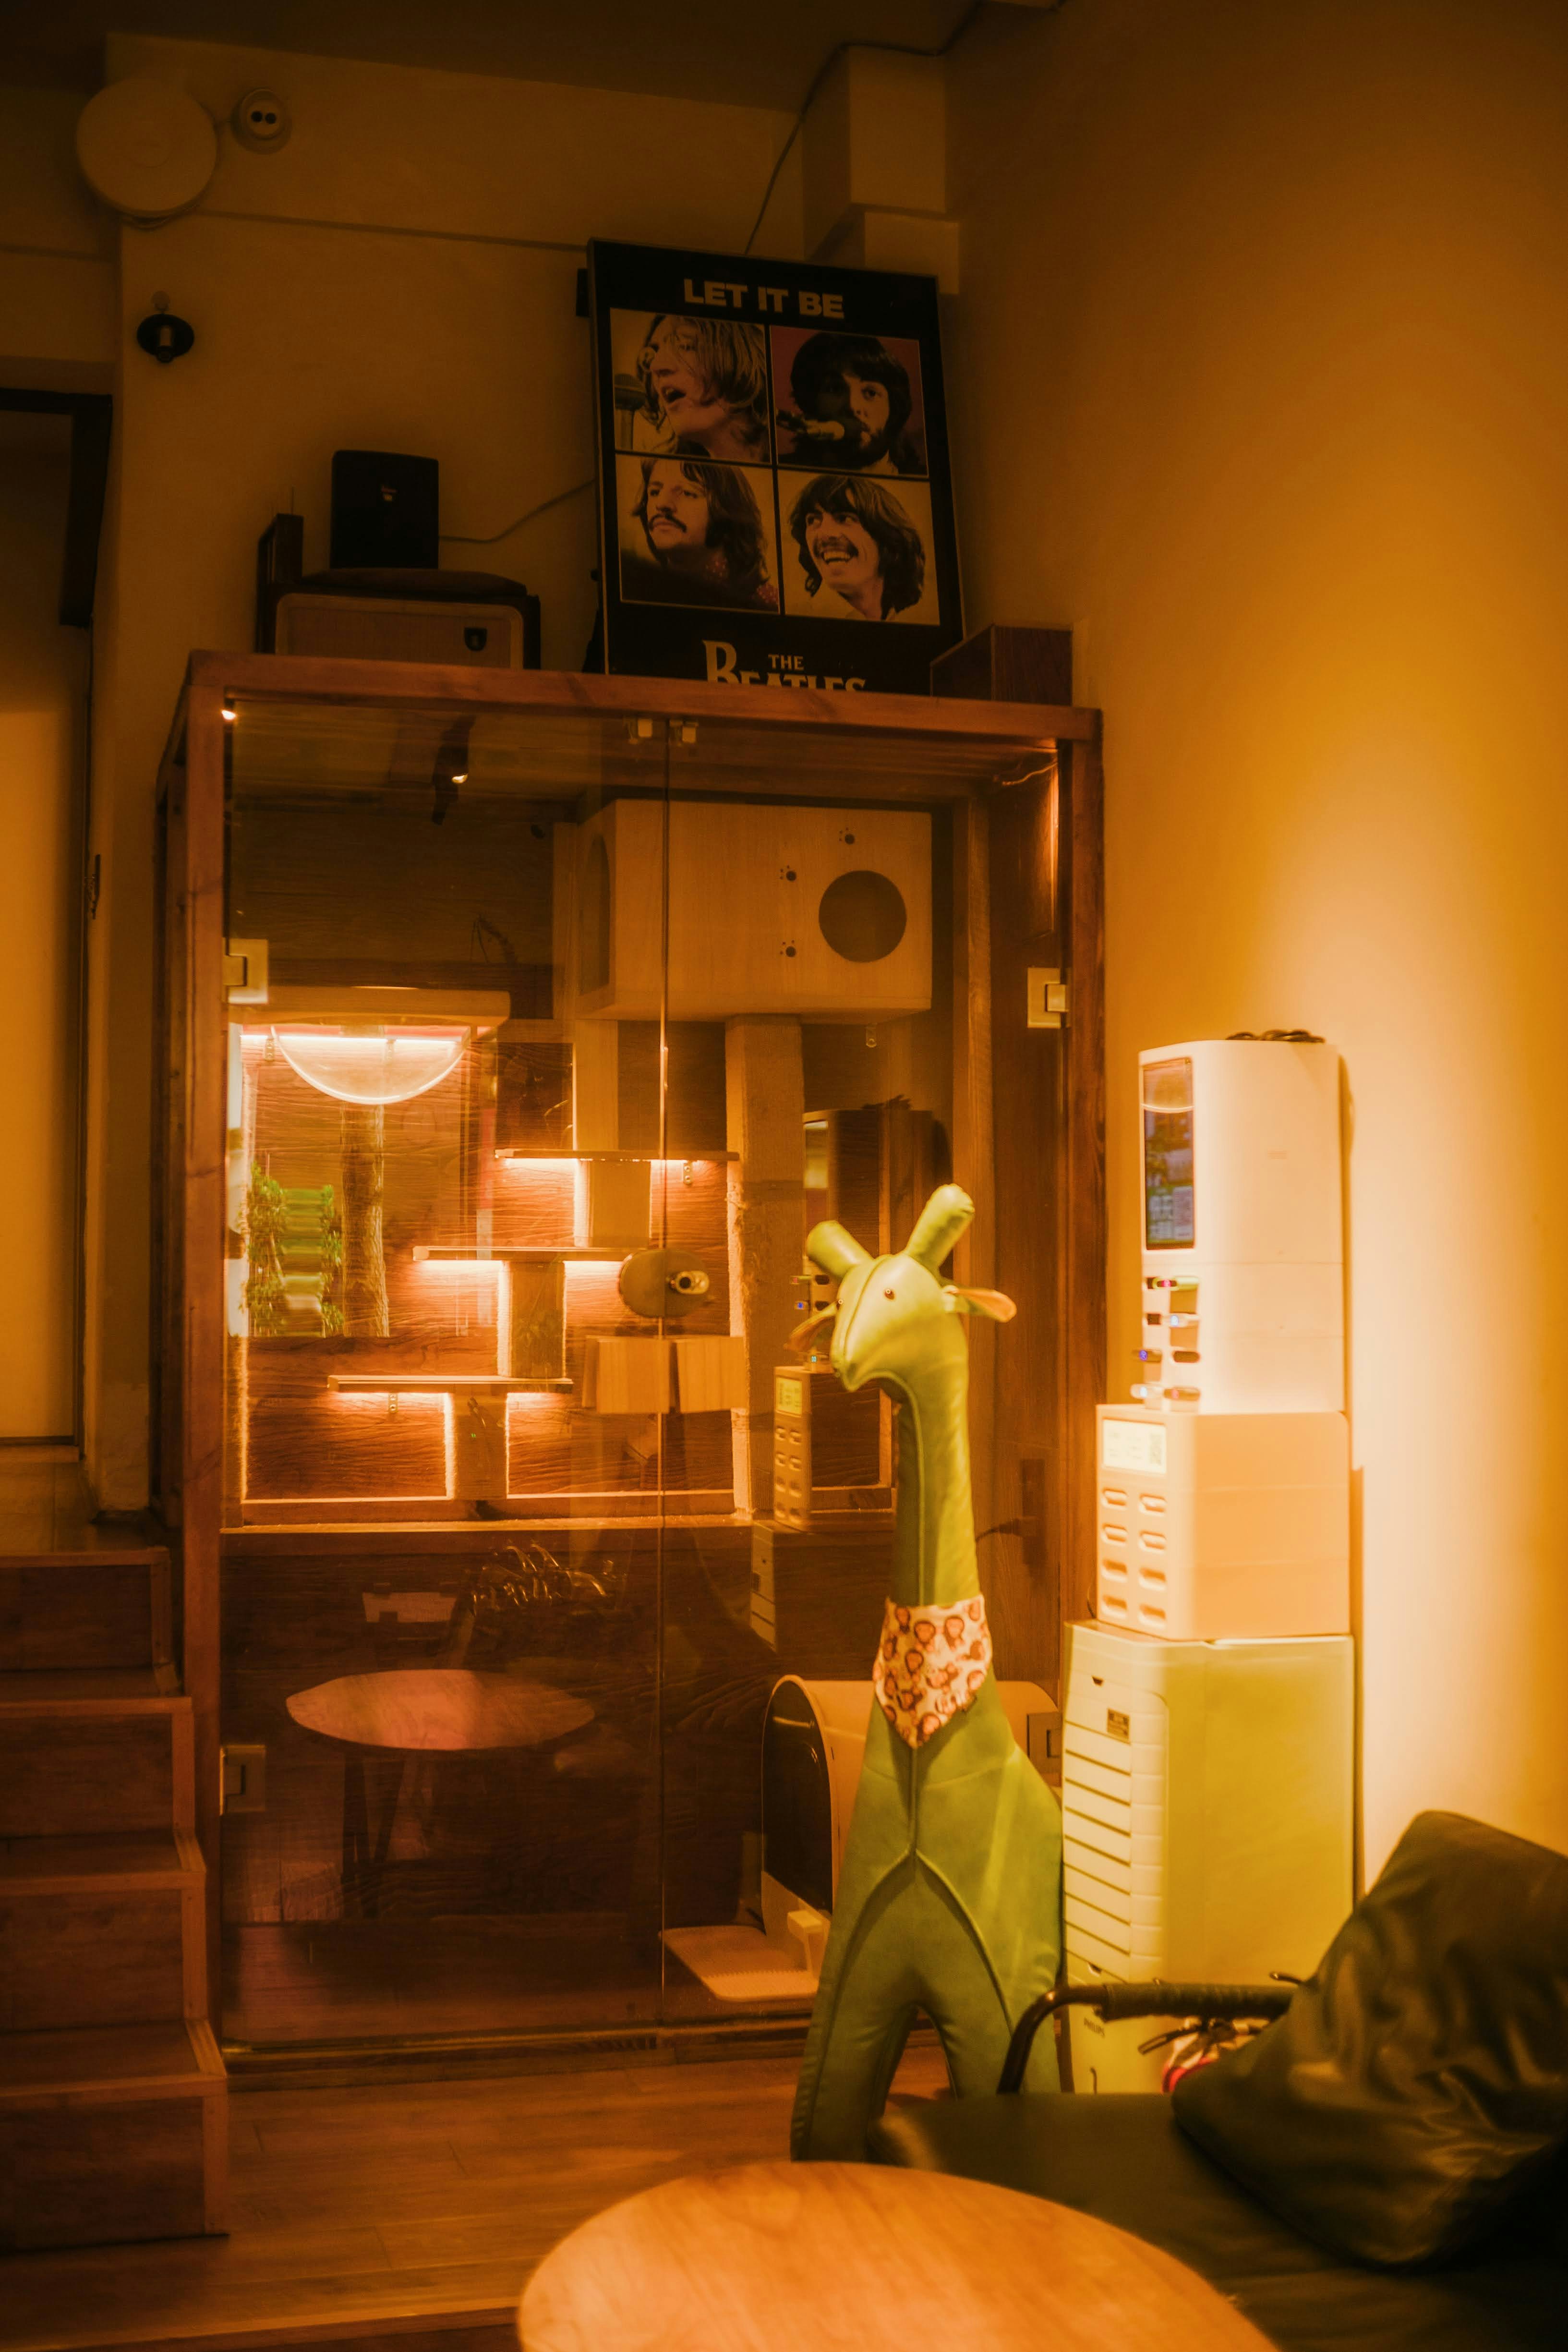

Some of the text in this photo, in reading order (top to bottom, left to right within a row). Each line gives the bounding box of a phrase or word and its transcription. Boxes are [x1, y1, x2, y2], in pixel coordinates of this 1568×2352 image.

[684, 278, 845, 319] LET IT BE
[768, 653, 805, 671] THE
[1084, 2017, 1105, 2037] PHILIPS
